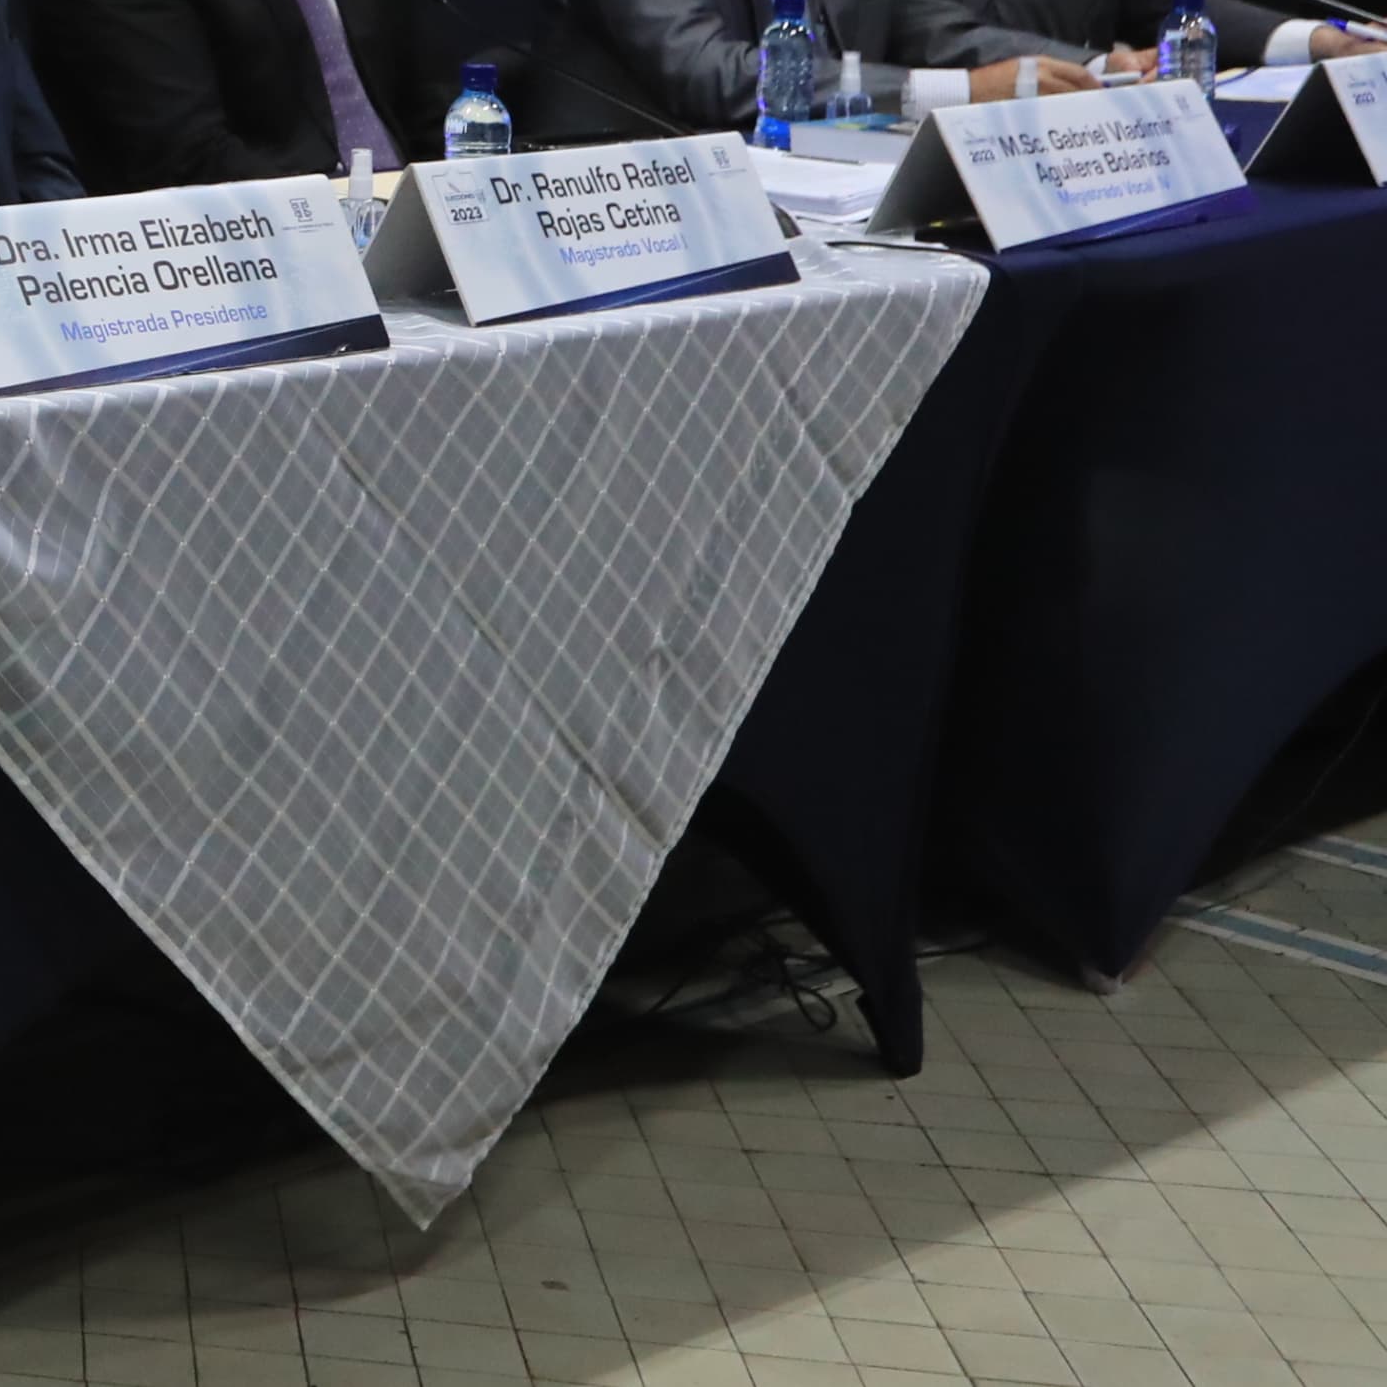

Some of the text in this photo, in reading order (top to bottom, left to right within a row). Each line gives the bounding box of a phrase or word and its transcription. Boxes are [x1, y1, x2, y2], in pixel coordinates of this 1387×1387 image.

[998, 133, 1048, 157] M.Sc.
[1047, 123, 1109, 151] Gabriel
[489, 156, 696, 205] Dr. Ranulfo Rafael
[1035, 157, 1104, 188] Aguilera
[61, 228, 138, 259] Irma
[139, 209, 275, 250] Elizabeth
[450, 206, 483, 222] 2023
[536, 199, 682, 241] Rojas Cetina
[559, 239, 641, 267] Magistrado
[641, 233, 681, 254] Vocal
[17, 254, 278, 306] Palencia Orellana
[60, 303, 268, 343] Magistrada Presidente
